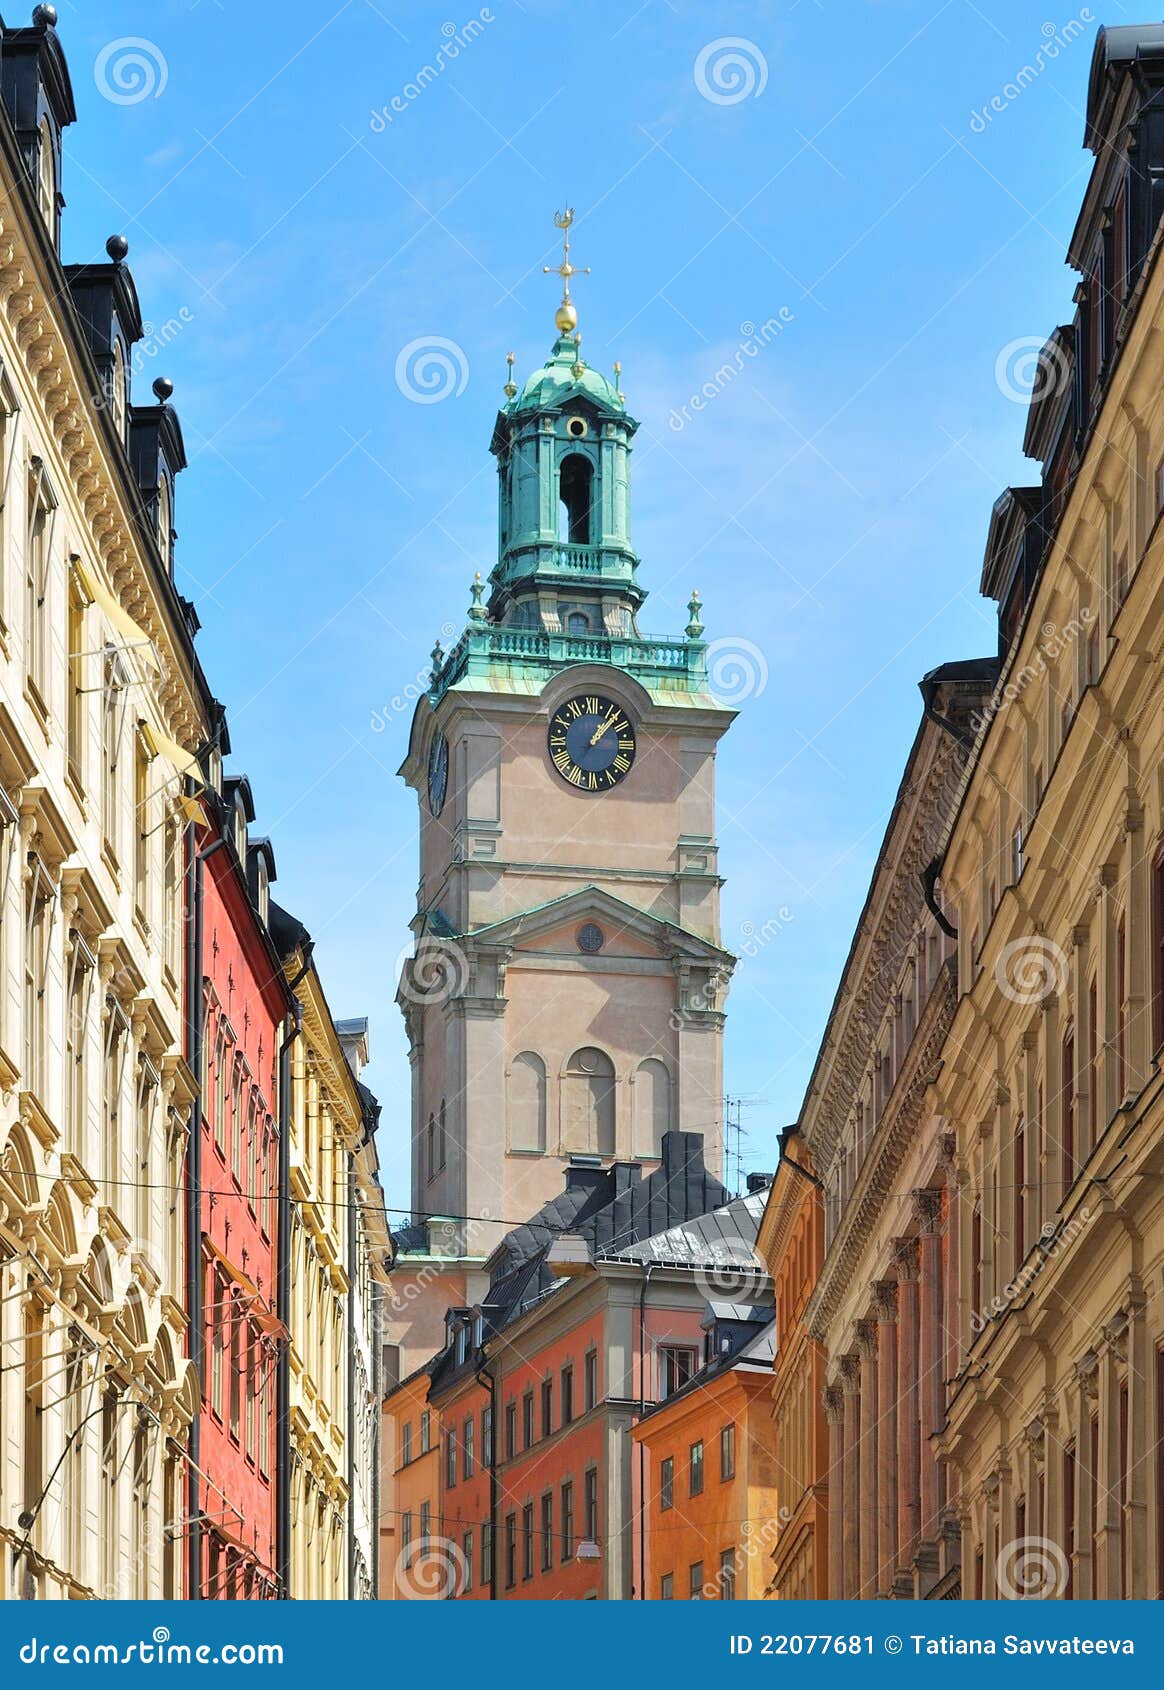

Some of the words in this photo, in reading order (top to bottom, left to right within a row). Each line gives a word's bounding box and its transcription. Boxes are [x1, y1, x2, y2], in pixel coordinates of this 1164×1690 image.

[568, 700, 582, 719] XI
[586, 697, 598, 714] XII
[555, 715, 570, 729] X
[614, 720, 629, 732] II
[550, 735, 565, 746] IX
[618, 740, 634, 750] III
[589, 772, 597, 788] VI
[605, 769, 616, 785] V
